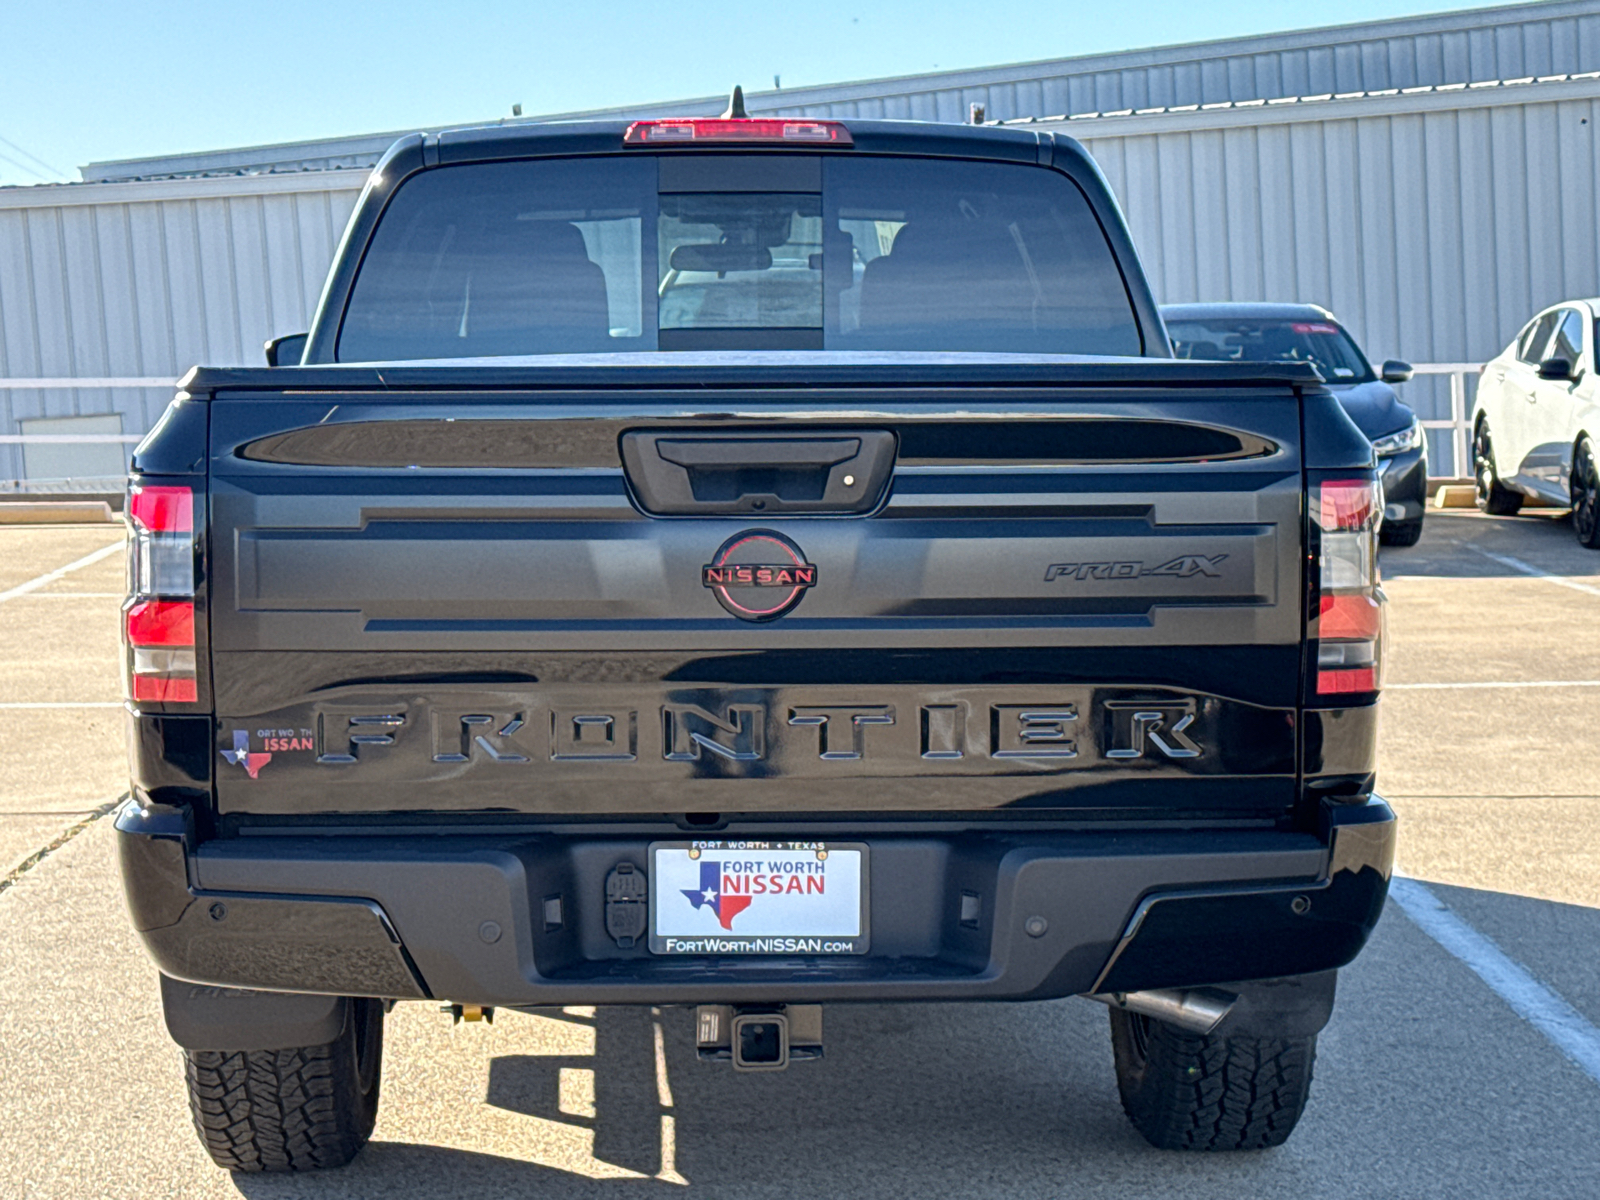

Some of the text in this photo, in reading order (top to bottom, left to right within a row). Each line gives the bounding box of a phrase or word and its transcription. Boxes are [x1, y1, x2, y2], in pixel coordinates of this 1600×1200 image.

[1044, 554, 1229, 582] PRO-4X
[707, 569, 813, 583] NISSAN
[314, 698, 1203, 763] FRONTIER
[264, 738, 313, 751] ISSAN
[692, 841, 722, 849] FORT
[788, 842, 826, 850] TEXAS
[722, 861, 825, 873] FORT WORTH
[723, 874, 825, 894] NISSAN
